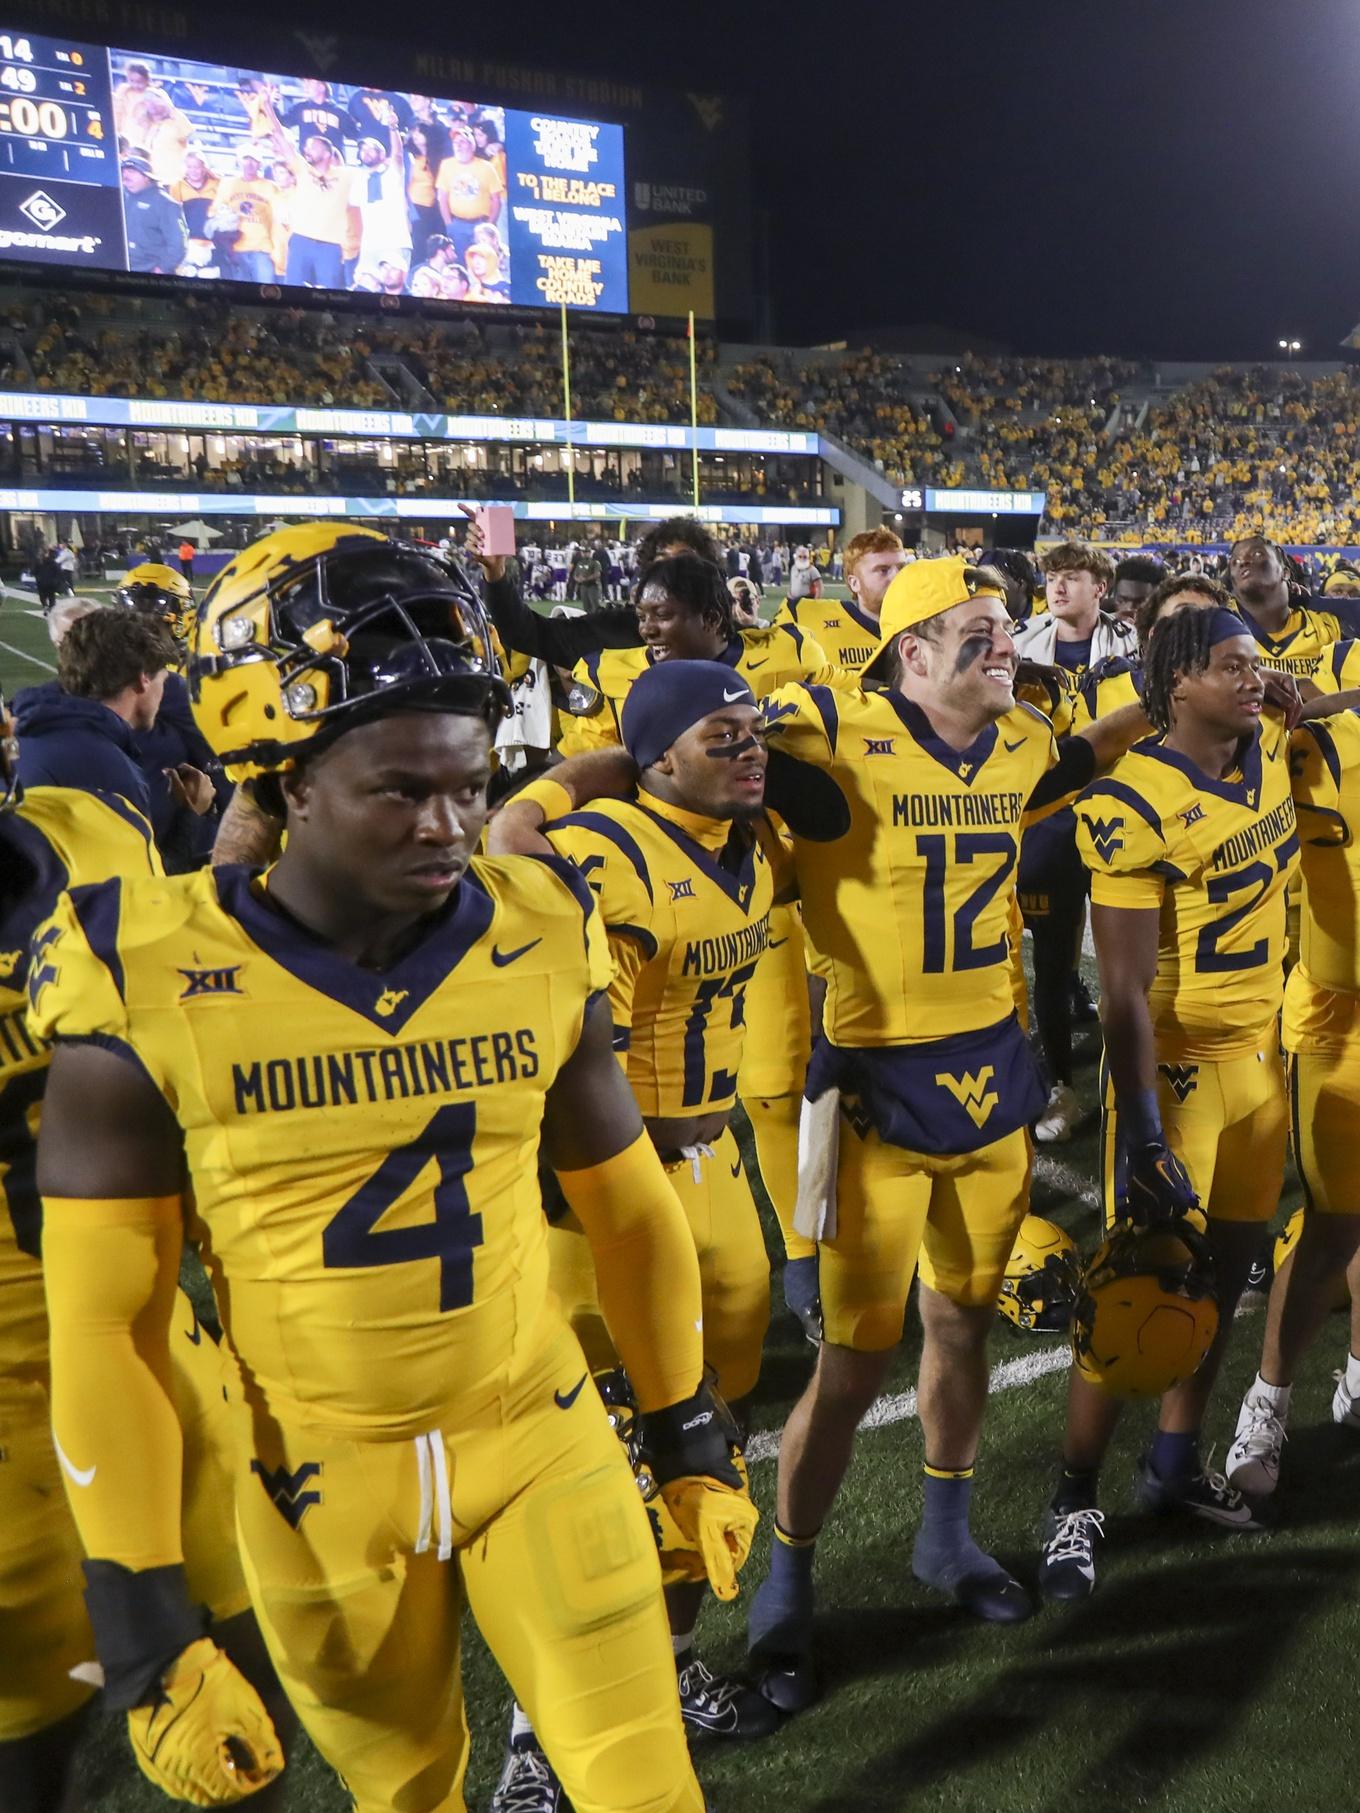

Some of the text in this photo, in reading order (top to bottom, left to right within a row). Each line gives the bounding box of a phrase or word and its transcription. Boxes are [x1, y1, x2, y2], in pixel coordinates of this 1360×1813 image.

[1, 65, 37, 93] 49
[517, 173, 616, 198] TO THE PLACE
[652, 184, 707, 203] UNITED
[534, 186, 601, 207] I BELONG
[652, 199, 692, 215] BANK
[651, 240, 689, 256] WEST
[537, 254, 601, 273] TAKE ME
[635, 252, 706, 273] VIRGINIA'S
[548, 266, 592, 283] HOME
[652, 270, 691, 286] BANK
[536, 276, 604, 296] COUNTRY
[545, 288, 596, 306] ROADS
[916, 831, 1019, 975] 12
[231, 1028, 540, 1116] MOUNTAINEERS
[321, 1100, 485, 1314] 4
